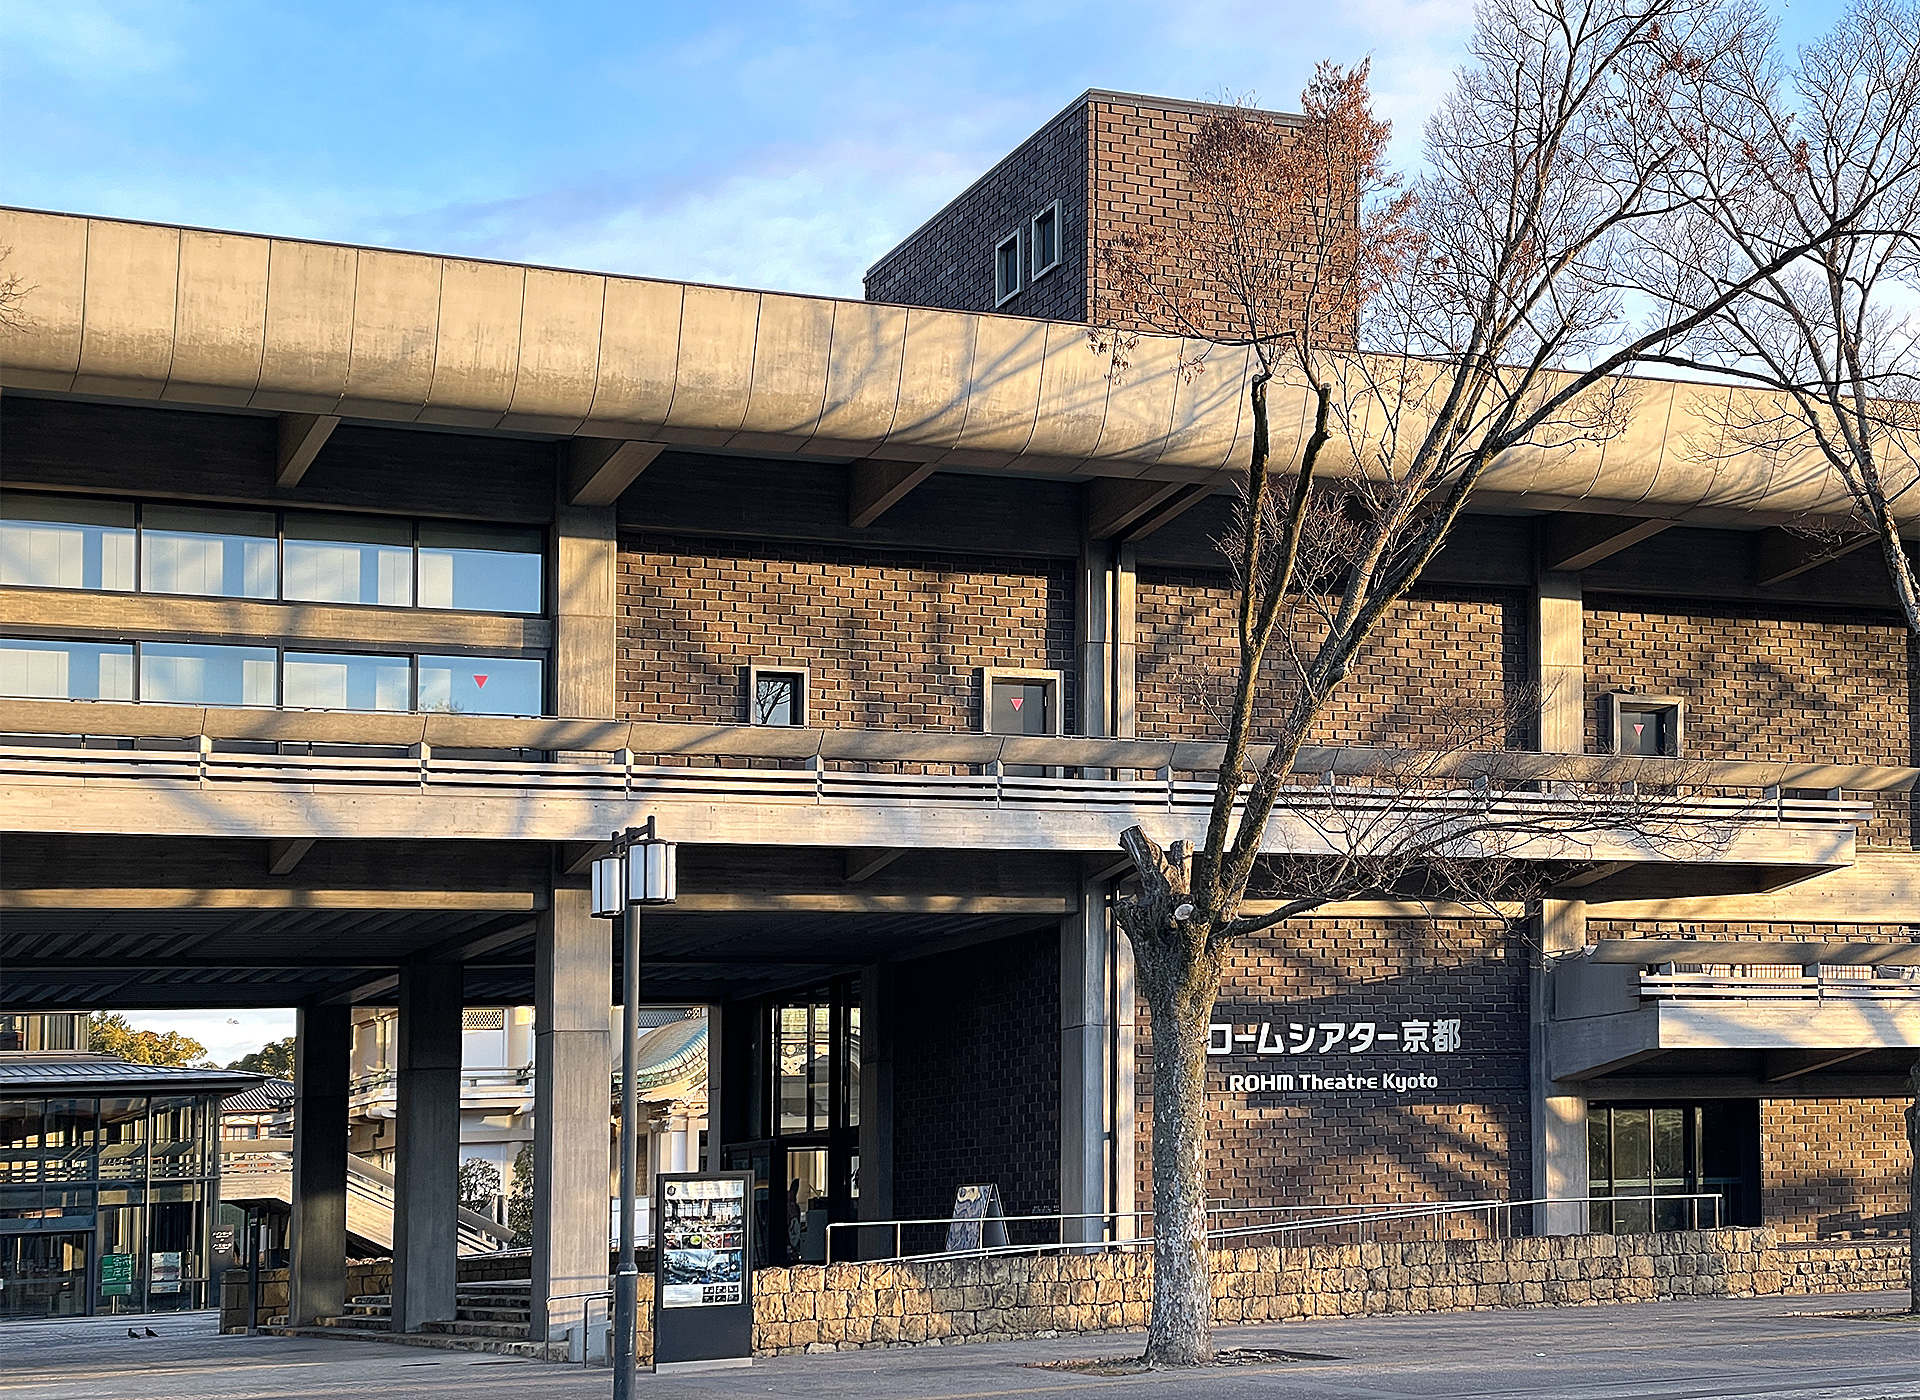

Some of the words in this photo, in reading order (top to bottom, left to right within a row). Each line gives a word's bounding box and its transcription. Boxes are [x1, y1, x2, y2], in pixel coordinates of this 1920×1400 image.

[1207, 1019, 1461, 1054] ロームシアター京都
[1229, 1073, 1294, 1092] ROHM
[1298, 1073, 1378, 1091] Theatre
[1382, 1072, 1438, 1093] Kyoto
